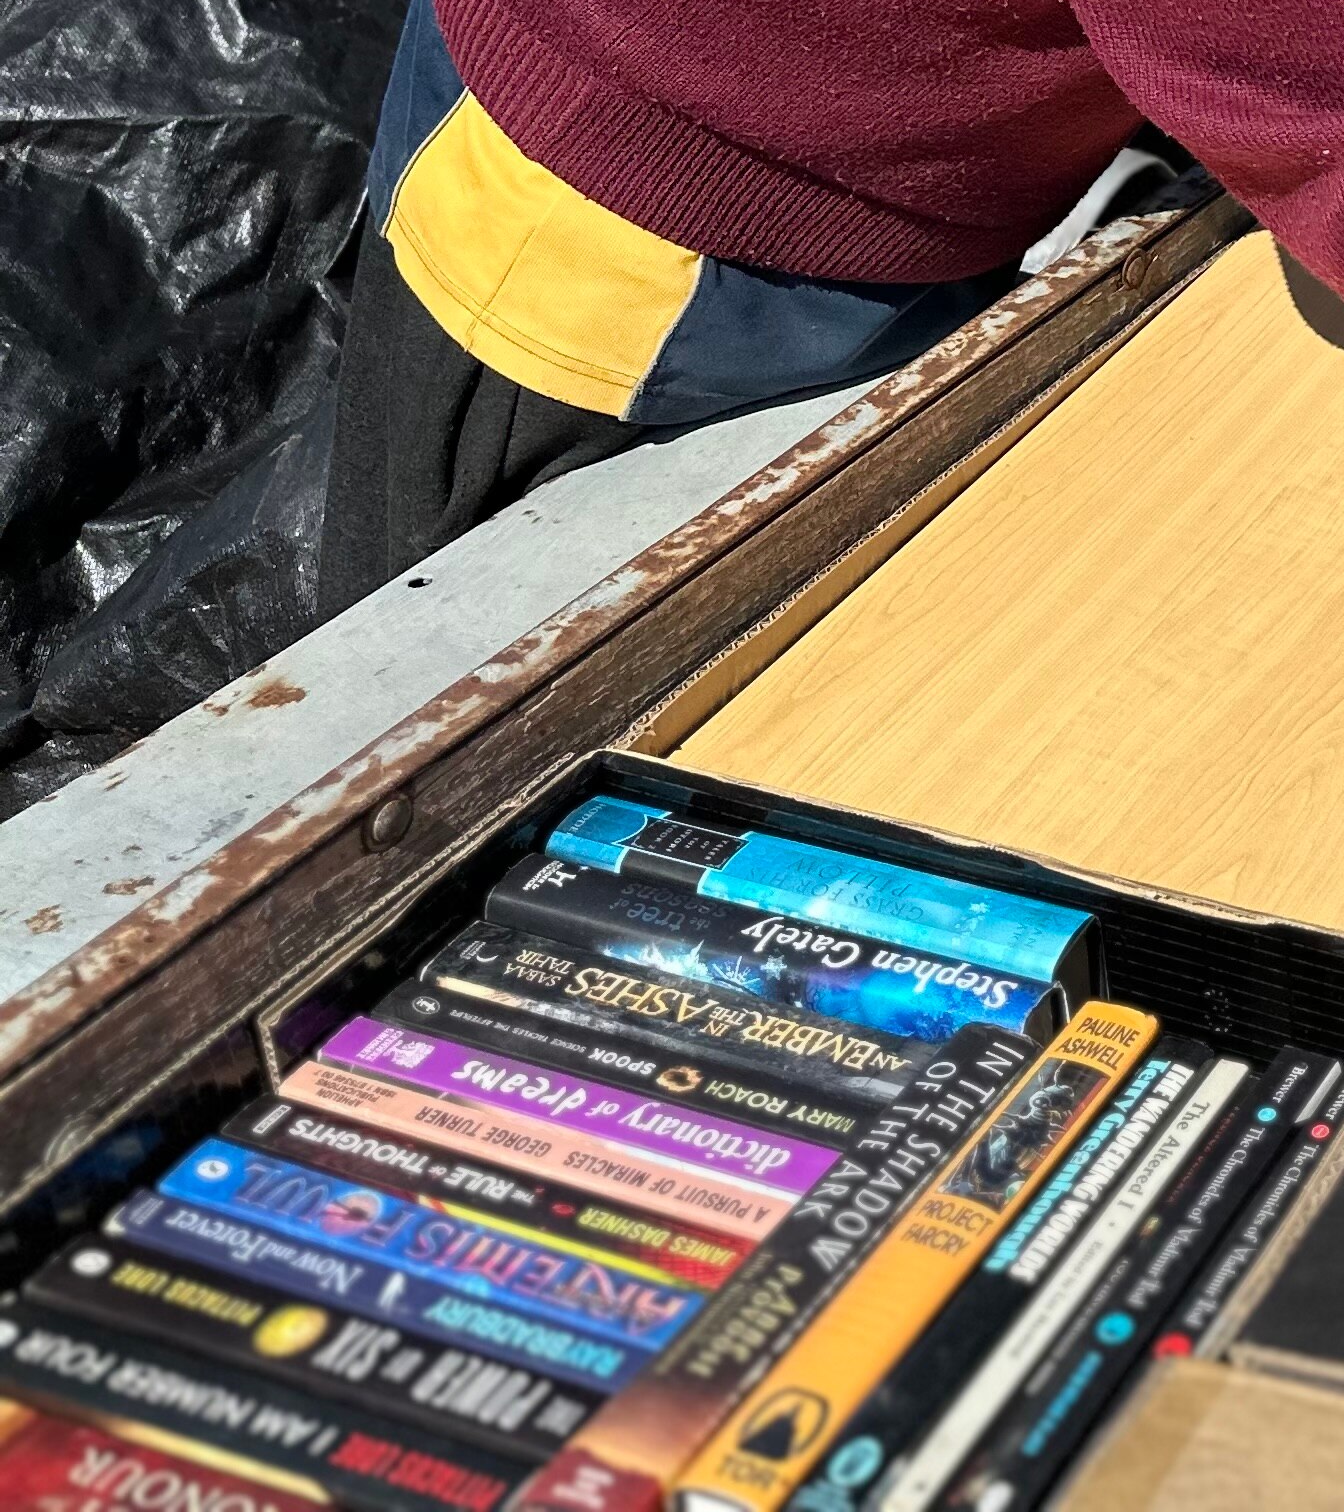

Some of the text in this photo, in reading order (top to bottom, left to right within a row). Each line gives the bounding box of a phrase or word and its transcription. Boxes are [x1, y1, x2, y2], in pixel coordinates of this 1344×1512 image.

[789, 856, 912, 899] PILLOW
[626, 902, 685, 931] tree
[503, 963, 562, 987] SABAA
[515, 949, 576, 974] TAHIR
[741, 916, 1018, 1010] Stephen Gately
[564, 967, 719, 1023] ASHES
[709, 1006, 744, 1026] THE
[742, 1008, 881, 1071] EMBER
[1055, 1037, 1125, 1071] ASHWELL
[1076, 1016, 1140, 1048] PAULINE
[451, 1060, 588, 1117] dreams
[584, 1099, 621, 1118] of
[588, 1047, 857, 1134] MARY ROACH SPOOK
[1112, 1059, 1172, 1116] Terry
[1152, 1063, 1195, 1102] THE
[1272, 1062, 1308, 1104] Brewer
[618, 1101, 792, 1175] dictionary
[794, 1061, 957, 1221] OF THE ARK
[1176, 1100, 1210, 1131] The
[1240, 1127, 1266, 1152] The
[289, 1119, 433, 1174] THOUGHTS
[414, 1105, 751, 1222] PURSUIT OF MIRACLES GEORGE TURNER
[808, 1041, 1025, 1272] IN THE SHADOW
[1076, 1096, 1170, 1204] WANDERING
[1127, 1134, 1181, 1197] Altered
[1293, 1144, 1319, 1168] The
[444, 1166, 514, 1202] RULE
[1199, 1148, 1248, 1209] Chronicles
[1253, 1166, 1302, 1226] Chronicles
[577, 1207, 672, 1246] DASHNER
[902, 1224, 970, 1258] FARCRY
[917, 1199, 994, 1238] PROJECT
[1007, 1199, 1090, 1284] WORLDS
[167, 1210, 364, 1295] Now Forever
[670, 1236, 737, 1267] JAMES
[1149, 1226, 1203, 1281] Vladimir
[1206, 1245, 1258, 1300] Vladimir
[15, 1330, 318, 1447] AM NUMBER FOUR
[311, 1319, 551, 1430] POWER SIX
